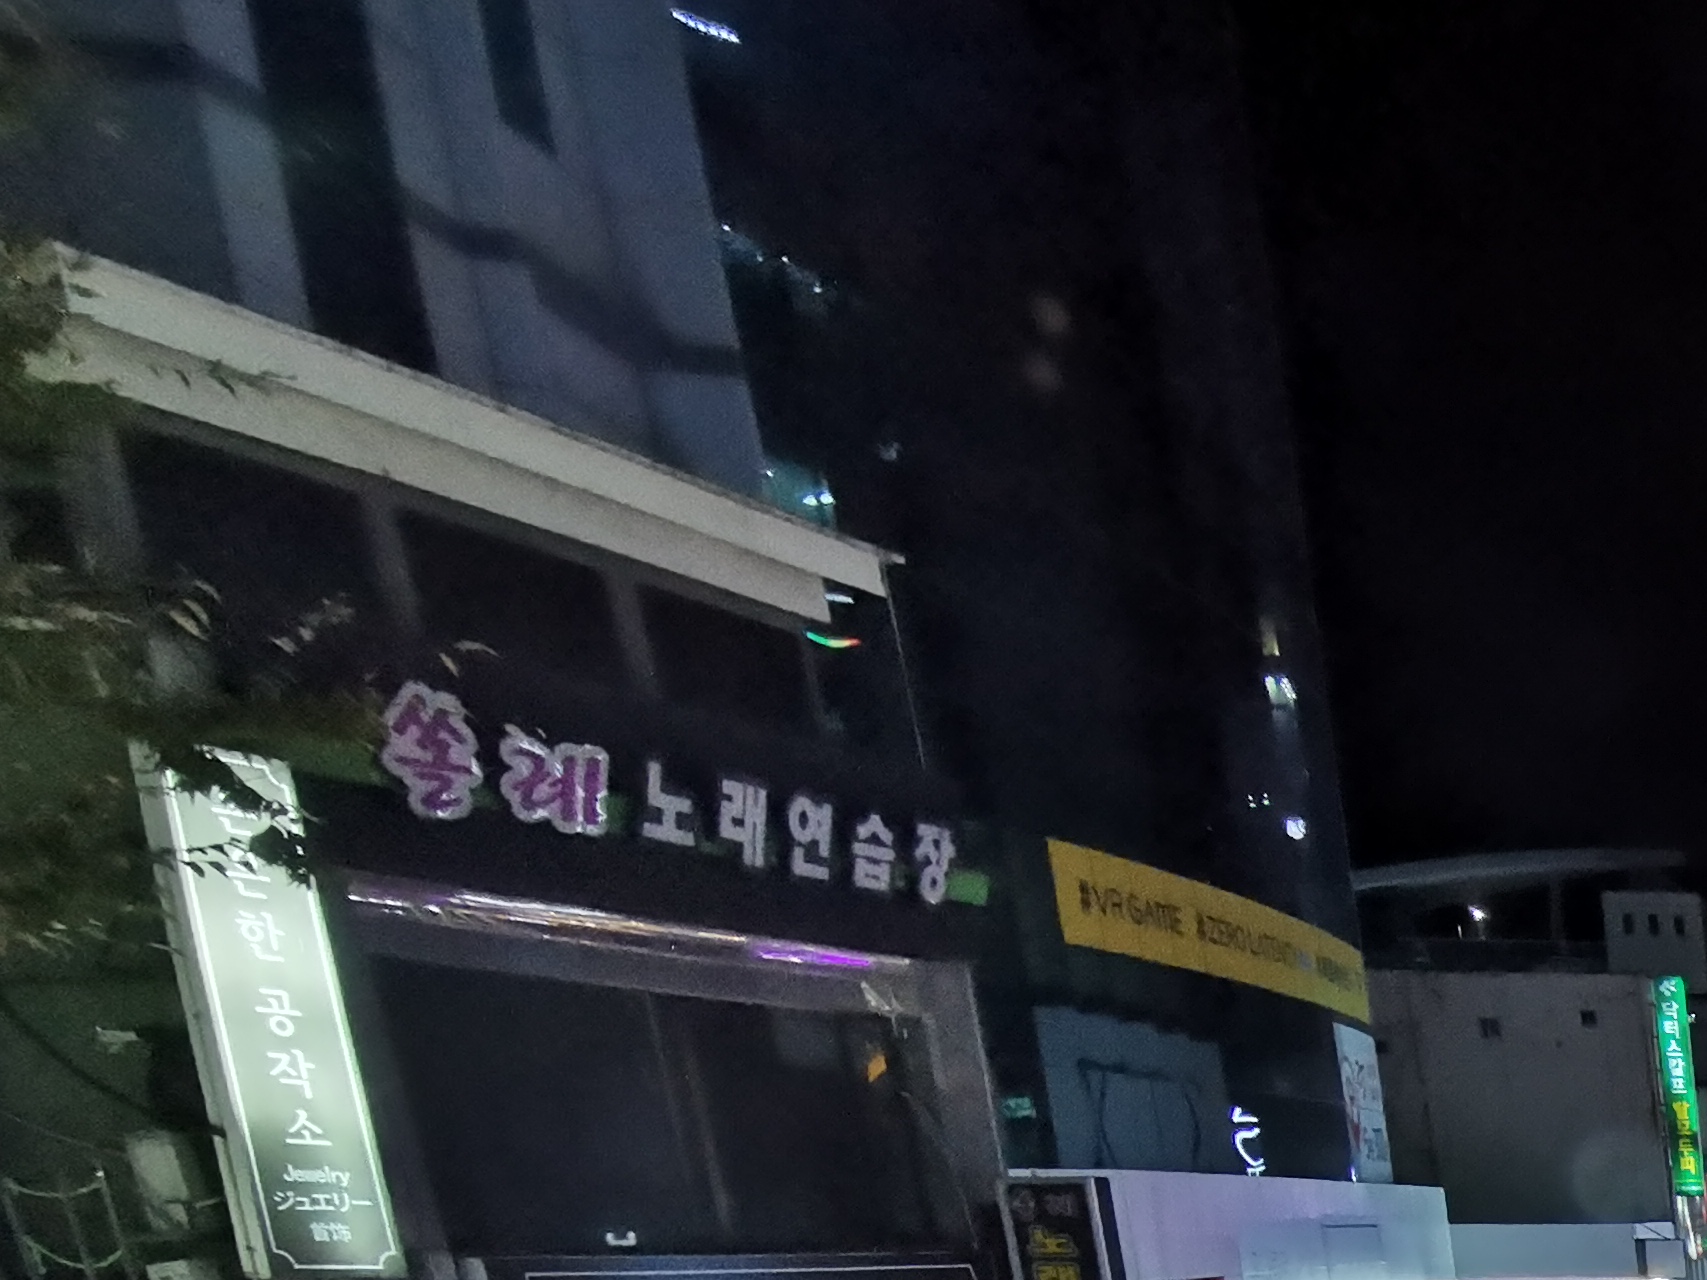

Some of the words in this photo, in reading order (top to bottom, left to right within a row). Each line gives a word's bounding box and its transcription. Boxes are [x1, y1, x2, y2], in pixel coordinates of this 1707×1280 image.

[640, 759, 956, 905] 노래연습장
[253, 992, 333, 1148] 공작소
[272, 1189, 374, 1213] ジュエリー
[282, 1163, 350, 1190] Jewelry
